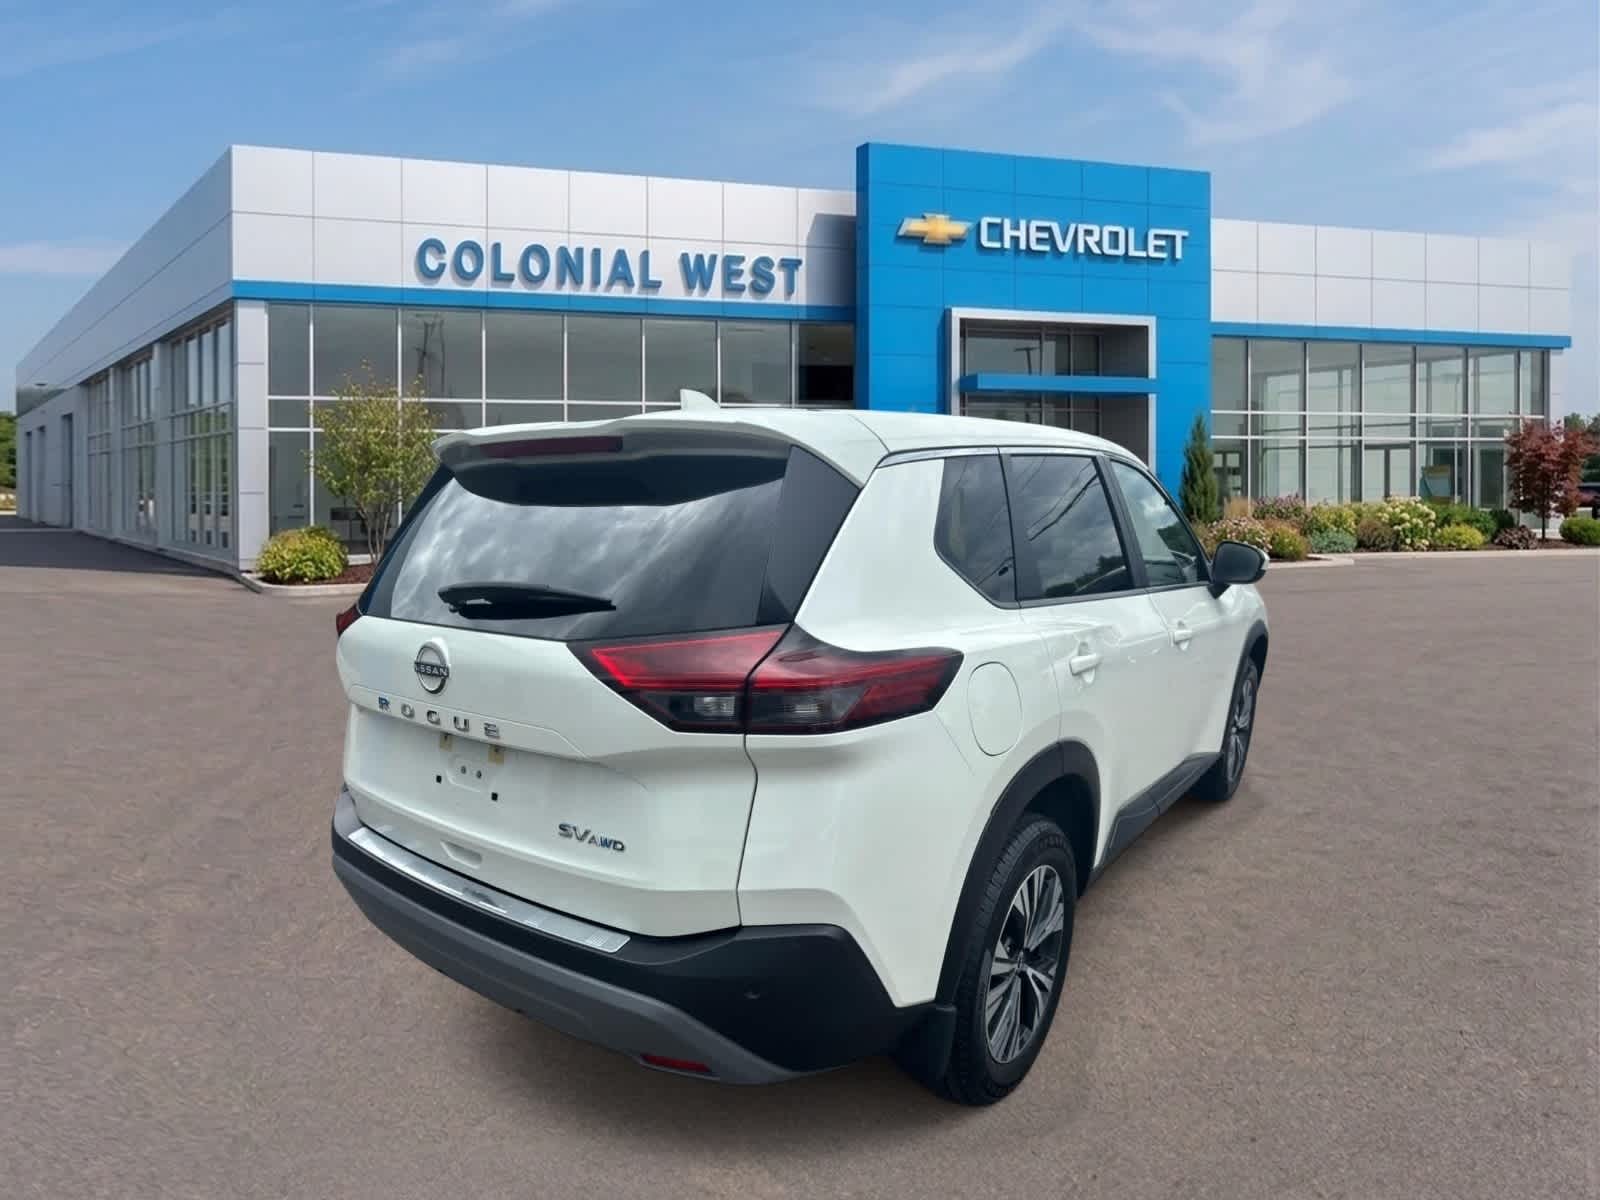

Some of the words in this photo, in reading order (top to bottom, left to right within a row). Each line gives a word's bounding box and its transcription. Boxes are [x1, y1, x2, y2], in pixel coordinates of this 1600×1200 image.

[979, 216, 1189, 260] CHEVROLET
[415, 238, 662, 289] COLONIAL
[679, 251, 802, 295] WEST
[414, 663, 449, 677] SSAN
[378, 696, 500, 739] ROGUE
